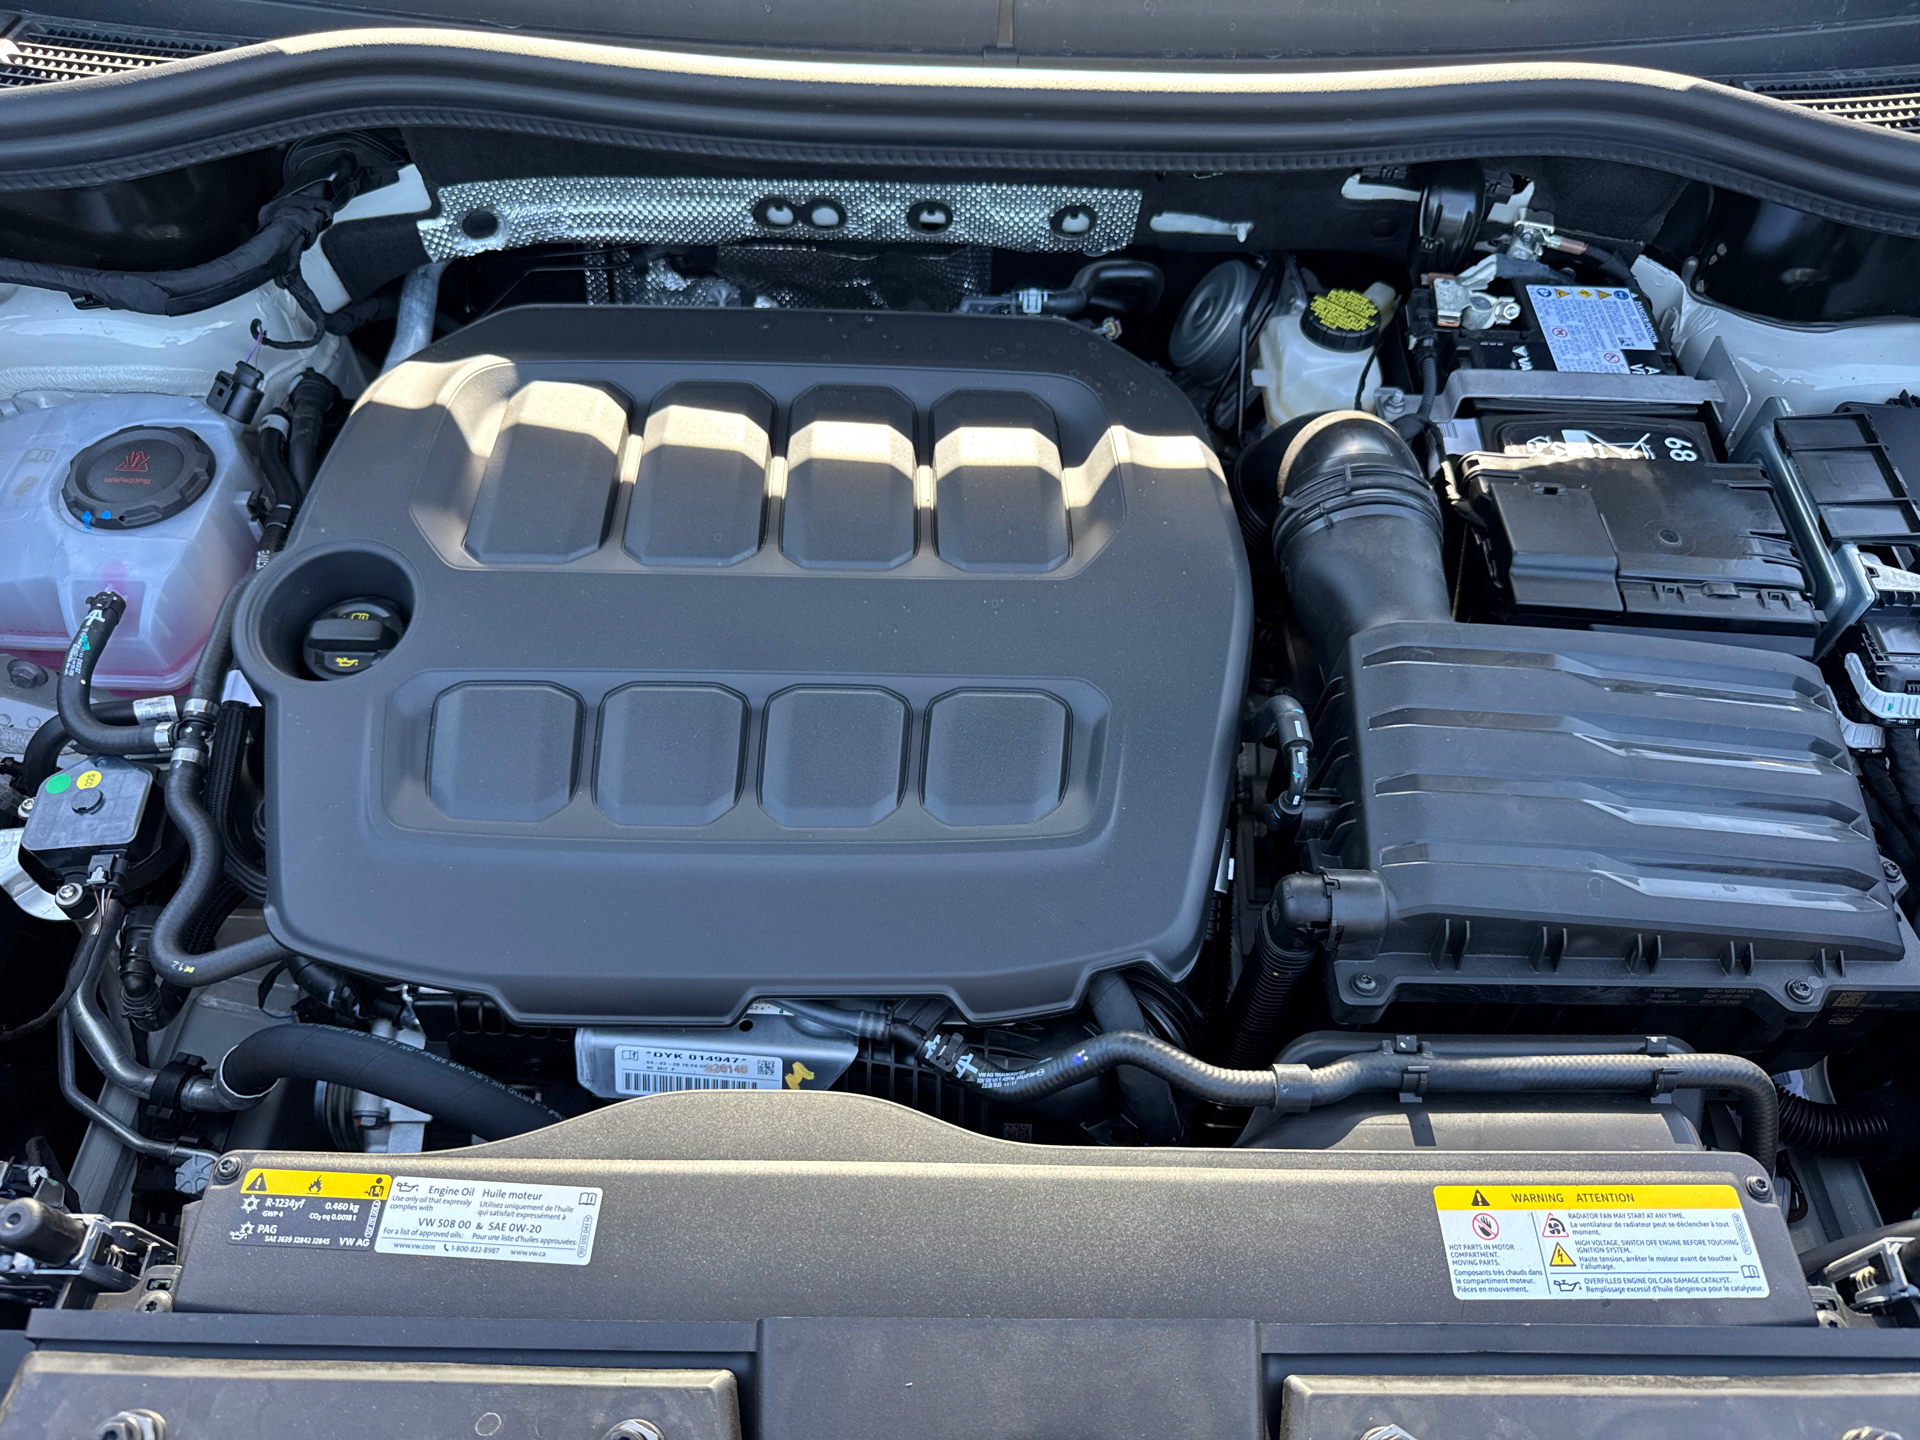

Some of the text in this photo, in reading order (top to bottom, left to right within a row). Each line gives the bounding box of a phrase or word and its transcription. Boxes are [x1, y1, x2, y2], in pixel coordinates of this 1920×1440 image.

[1664, 437, 1697, 462] 68
[428, 1185, 475, 1197] Engine Oil
[482, 1189, 543, 1201] Huile moteur
[405, 1196, 417, 1204] only
[442, 1198, 472, 1207] expressly
[1511, 1194, 1564, 1203] WARNING
[1576, 1194, 1635, 1203] ATTENTION
[265, 1198, 359, 1213] R-1234yf 0.460 kg
[389, 1204, 417, 1212] complies
[480, 1201, 503, 1209] Utilisez
[504, 1203, 543, 1212] uniquement
[478, 1210, 488, 1218] qui
[489, 1210, 515, 1218] satisfait
[257, 1224, 278, 1234] PAG
[418, 1218, 436, 1227] VW
[437, 1219, 456, 1229] 508
[458, 1220, 471, 1229] 00
[488, 1222, 507, 1231] SAE
[508, 1223, 542, 1234] 0W-20
[383, 1227, 393, 1235] For
[399, 1228, 409, 1236] list
[418, 1229, 449, 1239] approved
[472, 1232, 485, 1240] Pour
[499, 1234, 513, 1242] liste
[355, 1238, 370, 1246] AG
[451, 1245, 500, 1254] 1-800-822-8987
[511, 1249, 546, 1257] www.vw.ca
[1462, 1278, 1509, 1286] compartiment
[1586, 1286, 1625, 1294] Remplissage
[1675, 1286, 1707, 1294] dangereux
